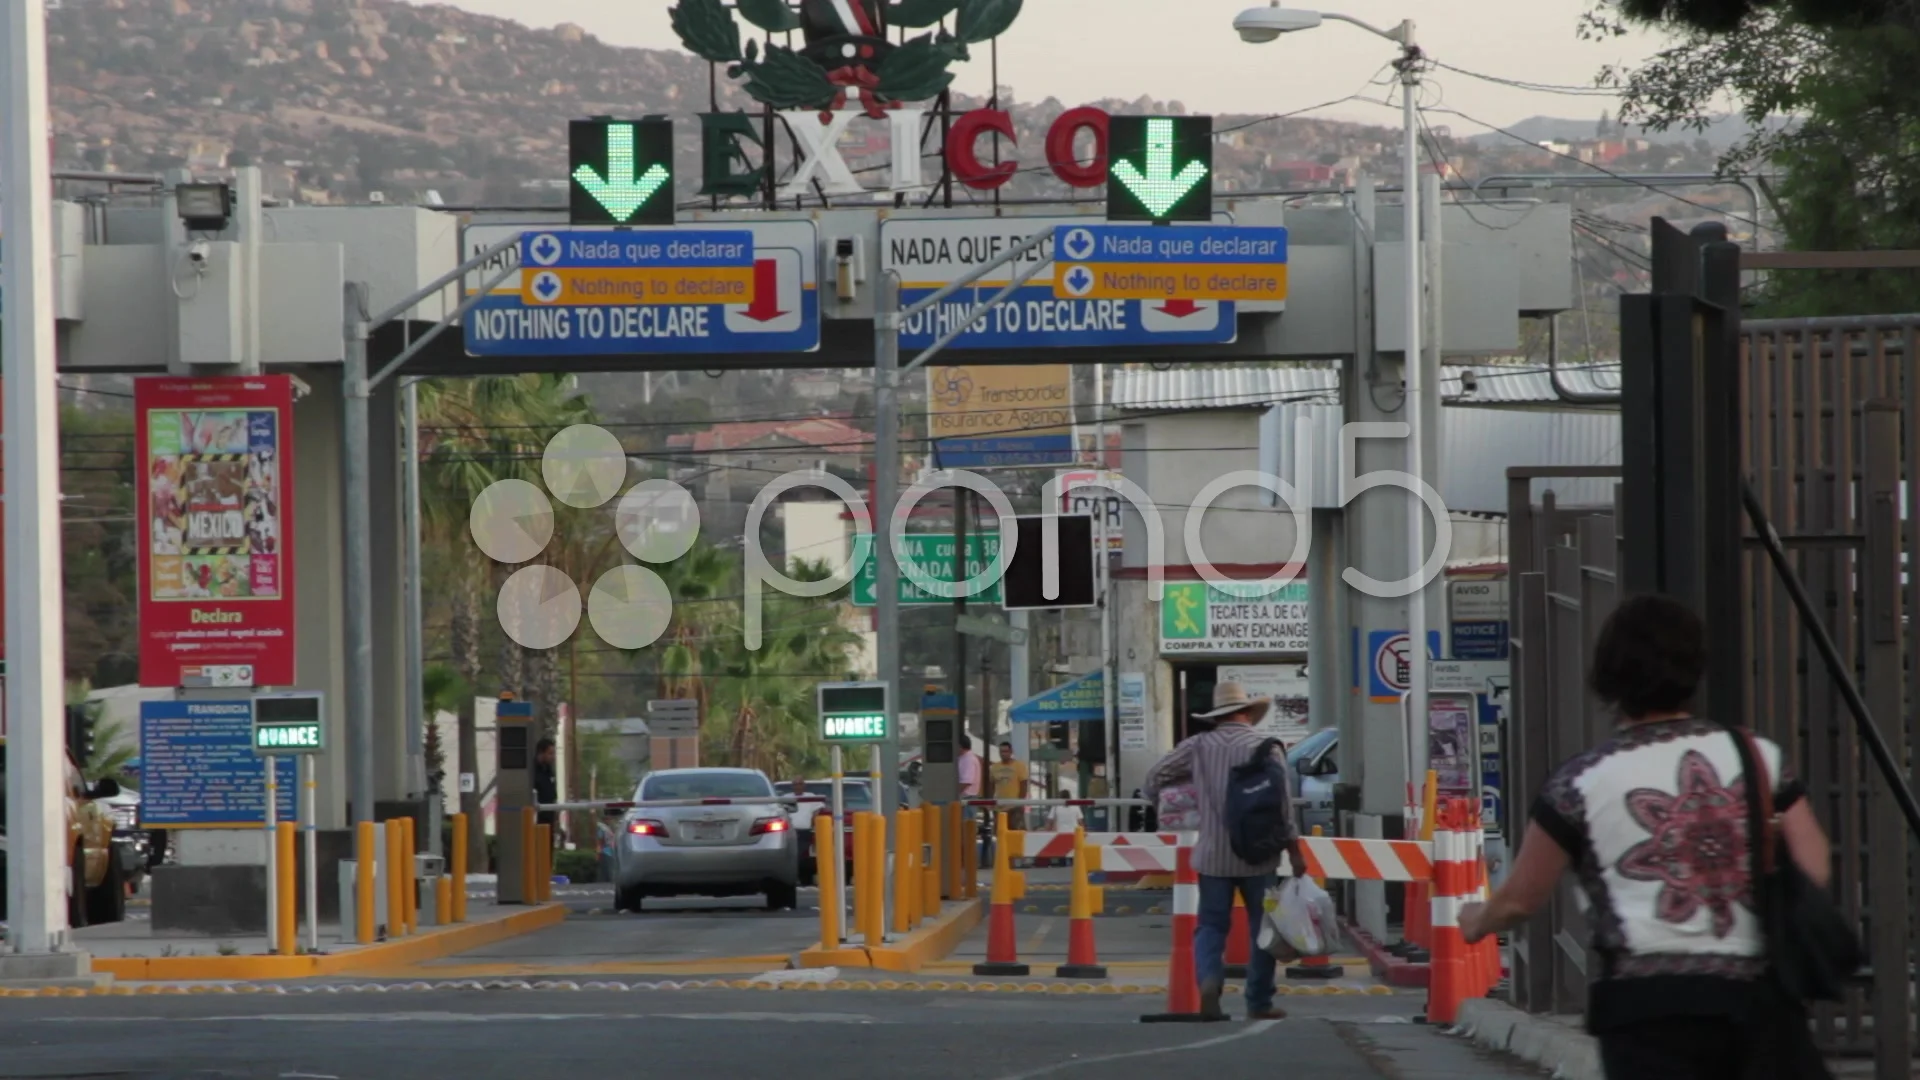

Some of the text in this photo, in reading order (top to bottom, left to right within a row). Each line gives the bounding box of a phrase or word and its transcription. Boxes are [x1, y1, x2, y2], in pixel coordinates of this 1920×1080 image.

[698, 107, 1110, 197] EXICO
[473, 242, 522, 270] NAD
[570, 239, 744, 264] Nada que declarar
[891, 238, 951, 265] NADA
[1103, 236, 1277, 259] Nada que declarar
[570, 276, 744, 299] Nothing to declare
[1103, 272, 1277, 294] Nothing to declare
[475, 306, 709, 340] NOTHING TO DECLARE
[994, 300, 1021, 332] TO
[1026, 300, 1126, 332] DECLARE
[980, 384, 1067, 402] Transborder
[933, 409, 1068, 429] Insurance Agency
[865, 541, 924, 557] TIANA
[865, 561, 953, 578] EENADA
[901, 581, 981, 599] MEXICLI
[1456, 586, 1489, 595] AVISO
[190, 607, 243, 623] Declara
[1210, 604, 1249, 619] TECATE
[1252, 604, 1270, 619] S.A.
[1274, 604, 1288, 619] DE
[1211, 622, 1308, 638] MONEY EXCHANGE
[1455, 625, 1496, 636] NOTICE
[1165, 641, 1213, 650] COMPRA
[1217, 641, 1224, 649] Y
[1228, 640, 1265, 649] VENTA
[1269, 640, 1286, 649] NO
[825, 716, 884, 736] AVANCE
[257, 726, 318, 747] AVANCE
